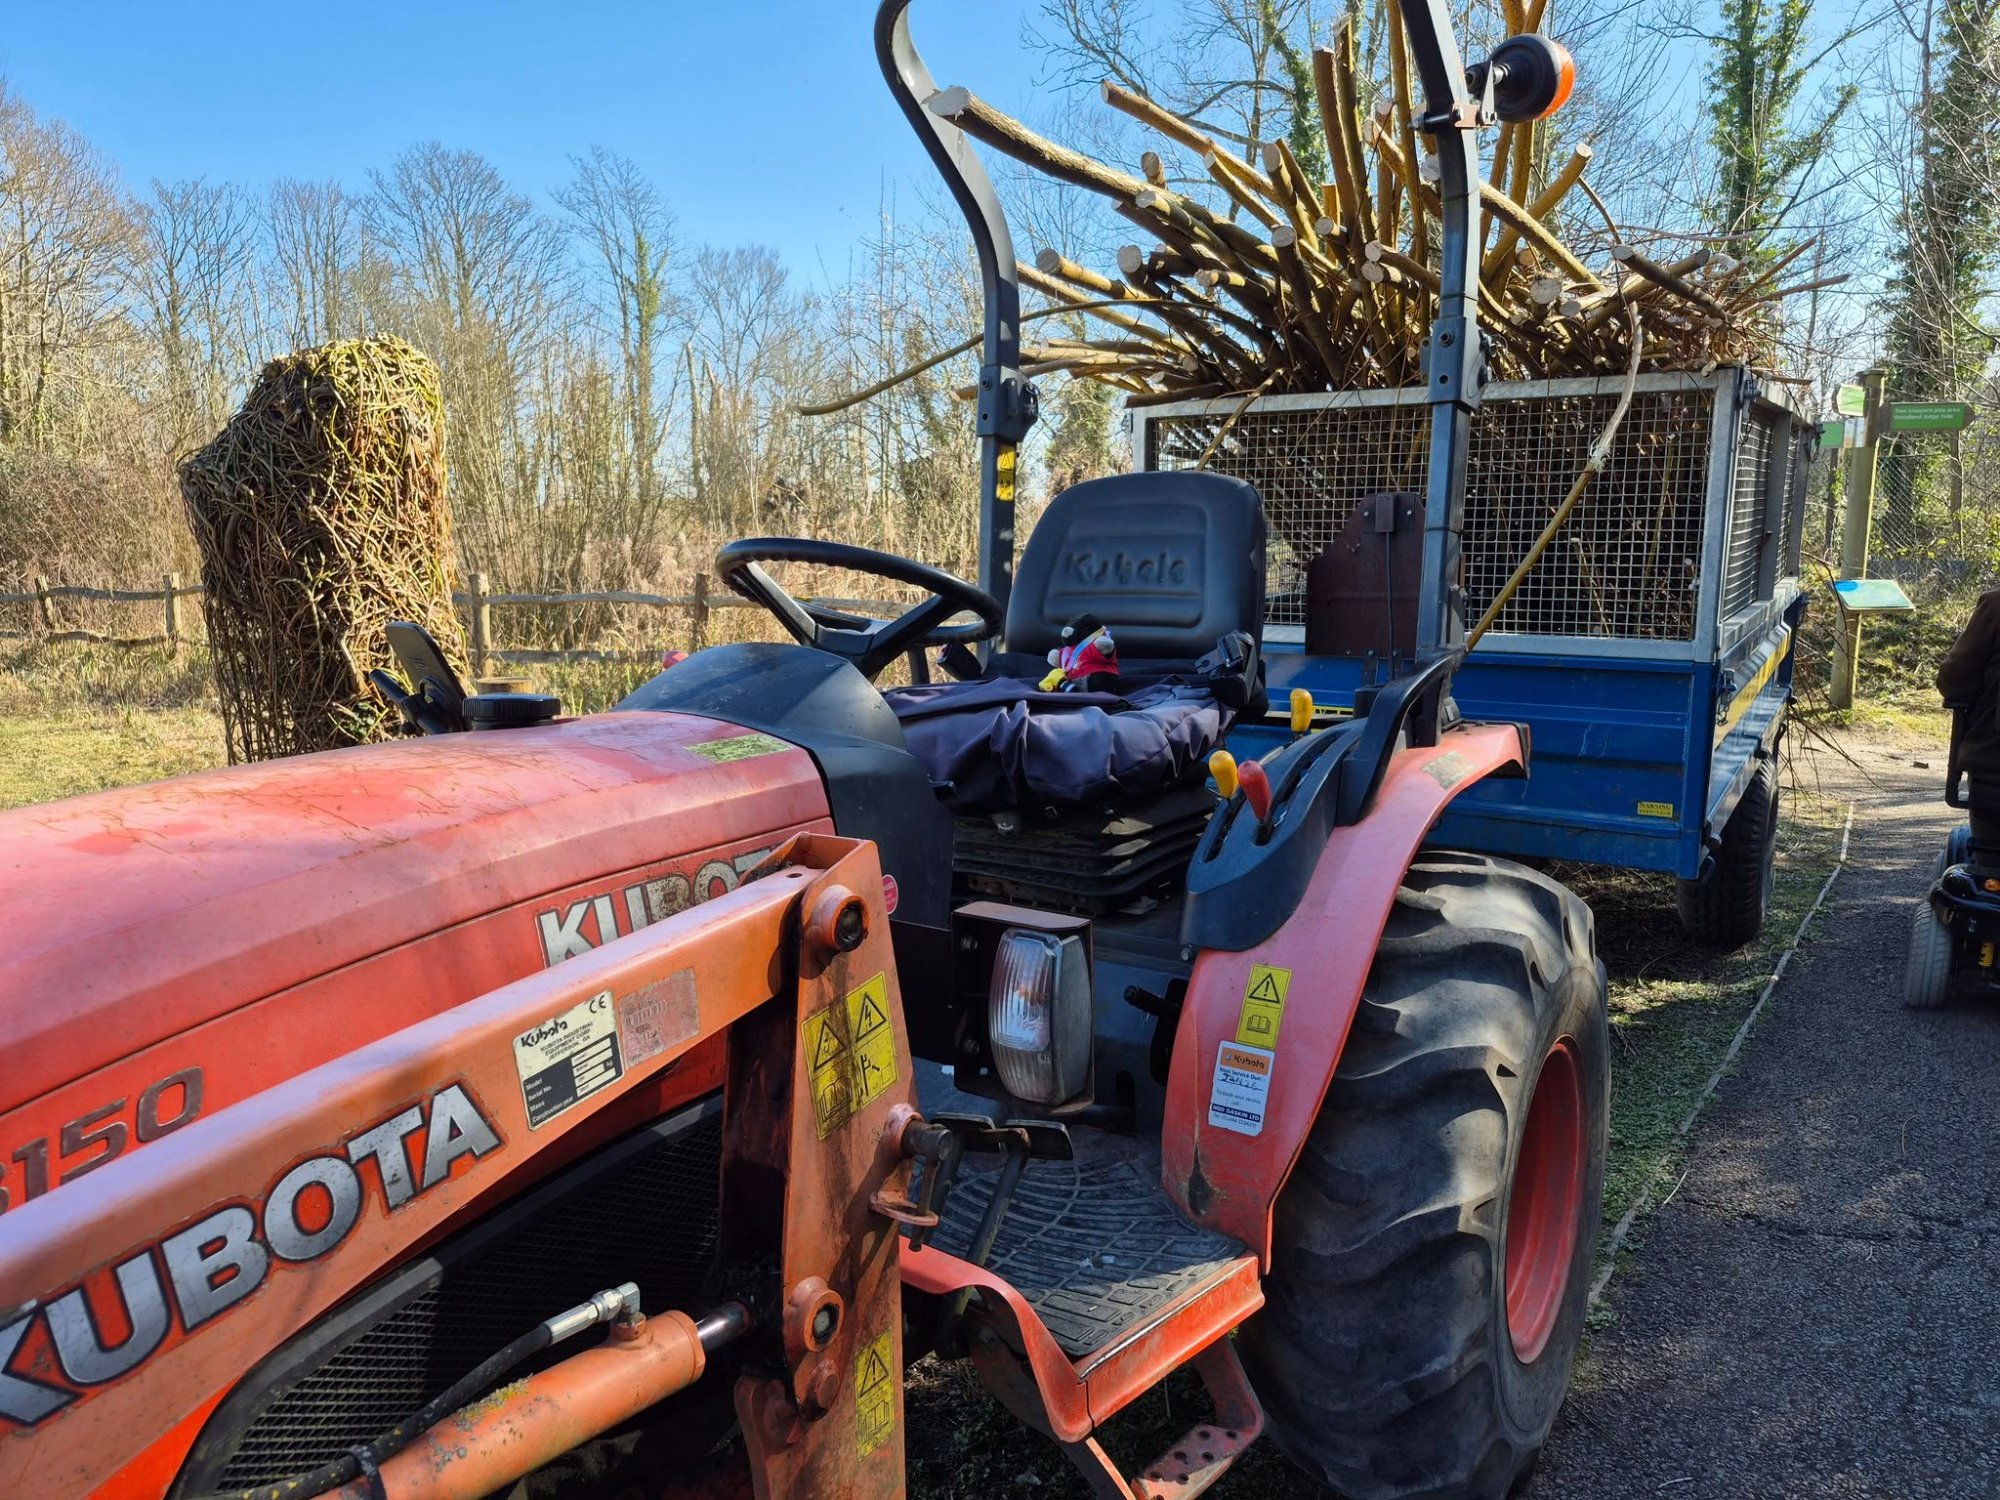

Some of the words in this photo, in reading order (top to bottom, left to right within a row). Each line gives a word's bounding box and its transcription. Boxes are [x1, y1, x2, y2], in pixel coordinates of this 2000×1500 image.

[538, 845, 785, 968] KUBOT
[521, 1019, 568, 1048] Kubota
[1233, 1054, 1265, 1069] Kubota
[1232, 1069, 1249, 1079] Service
[525, 1077, 543, 1091] Model
